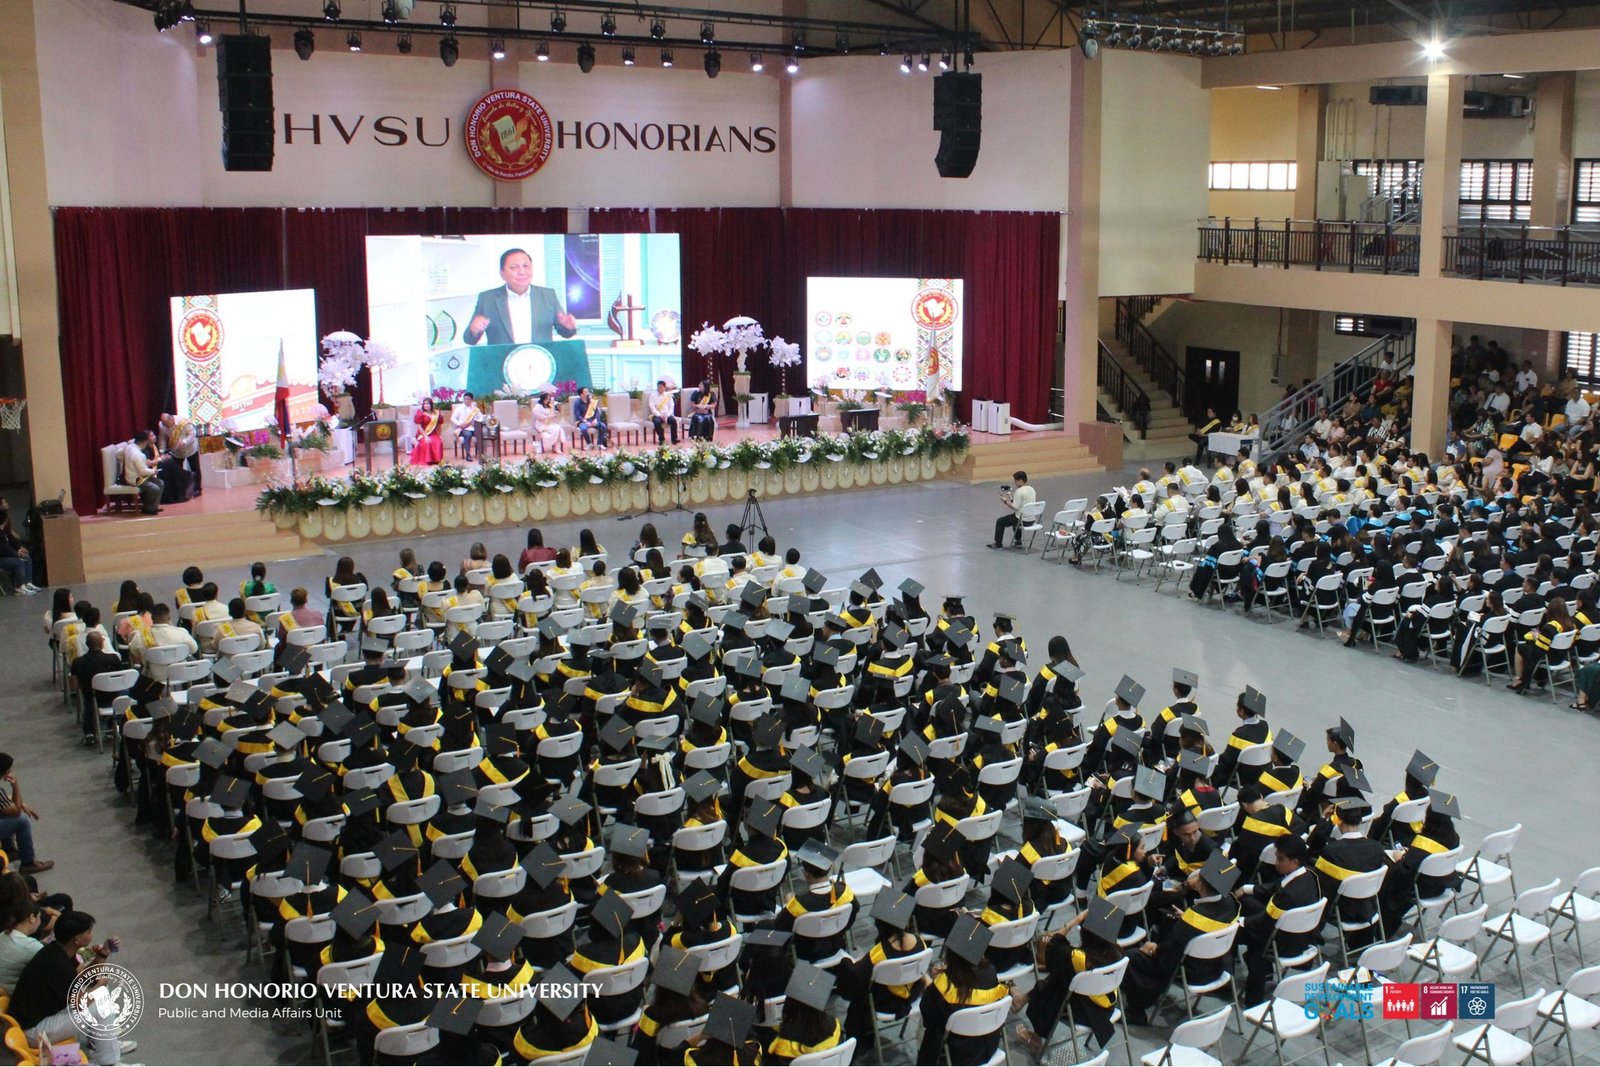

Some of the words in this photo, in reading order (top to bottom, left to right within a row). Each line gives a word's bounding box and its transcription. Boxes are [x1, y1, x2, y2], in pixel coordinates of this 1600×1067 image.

[485, 91, 521, 104] VENTURA
[521, 95, 543, 115] STATE
[469, 102, 486, 138] HONORIO
[500, 126, 516, 141] 1861
[539, 114, 552, 162] UNIVERSITY
[557, 120, 776, 153] HONORIANS
[470, 139, 482, 158] DON
